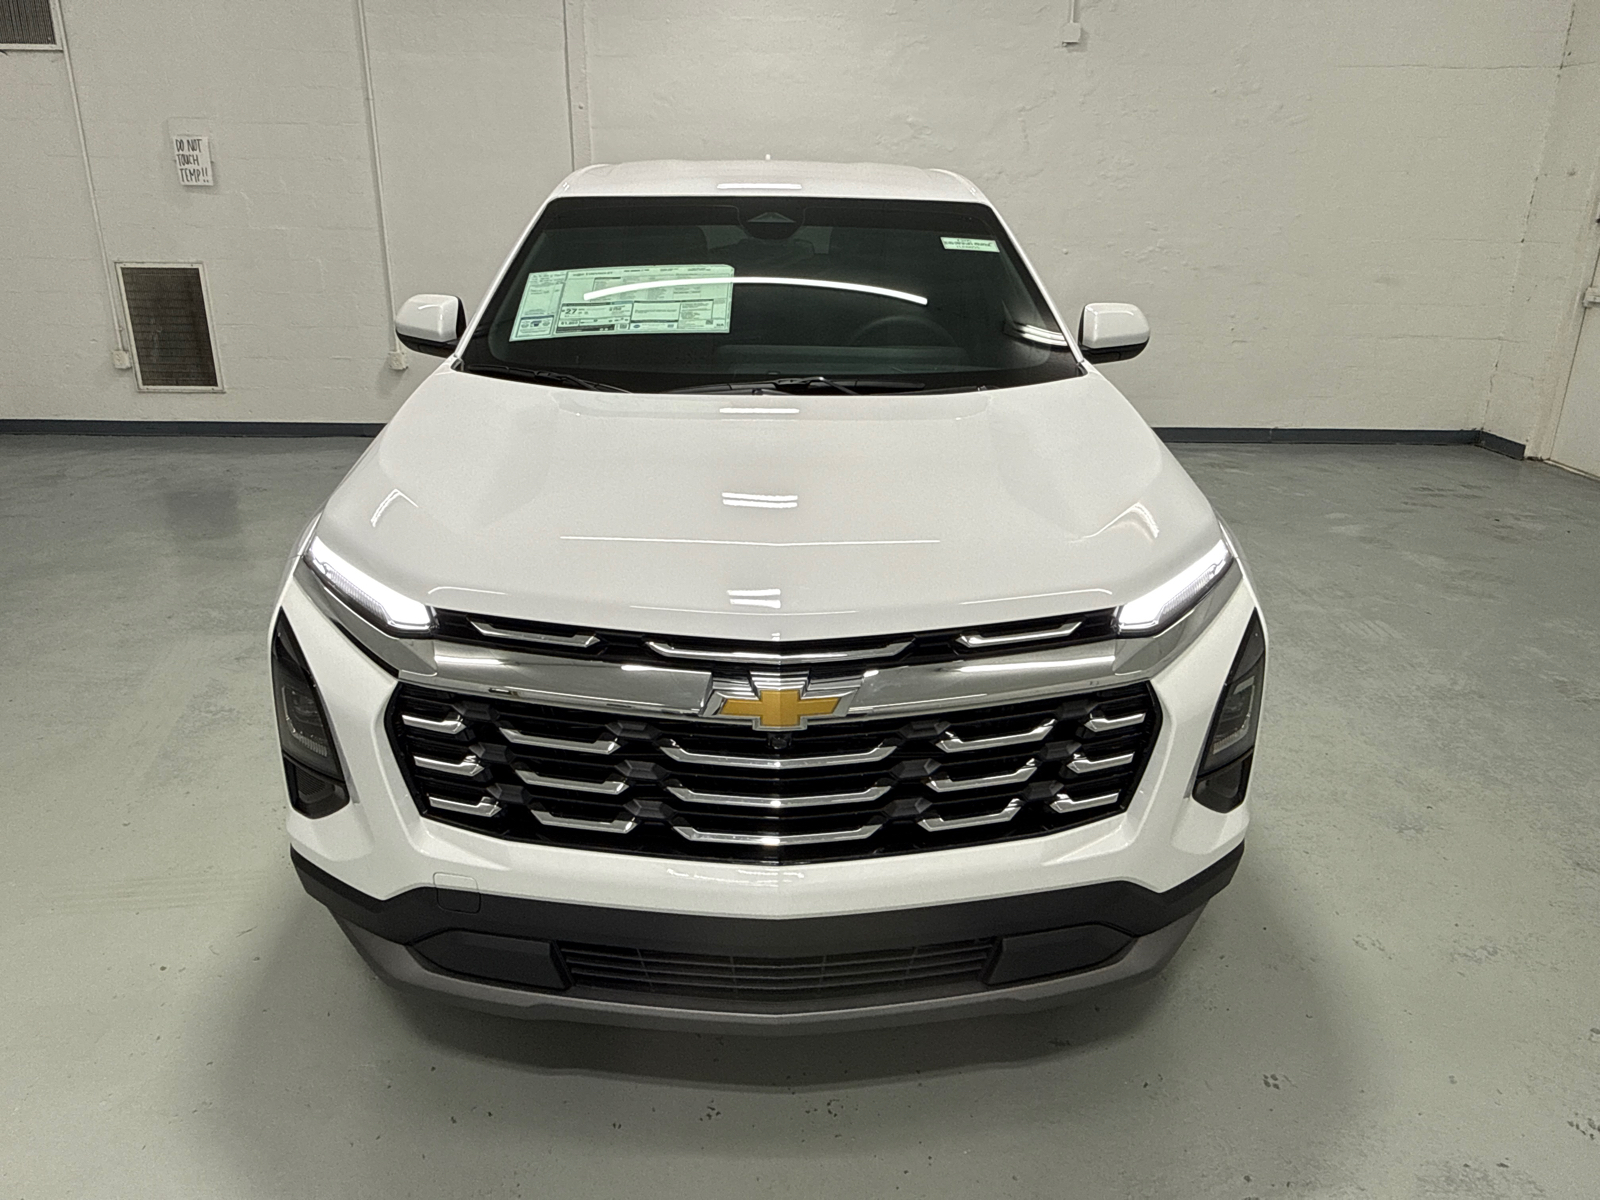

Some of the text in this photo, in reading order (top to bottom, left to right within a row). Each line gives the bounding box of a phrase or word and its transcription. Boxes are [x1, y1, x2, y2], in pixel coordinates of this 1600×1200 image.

[175, 138, 202, 153] DO NOT
[176, 153, 200, 167] TOUCH
[179, 167, 209, 183] TEMP!!
